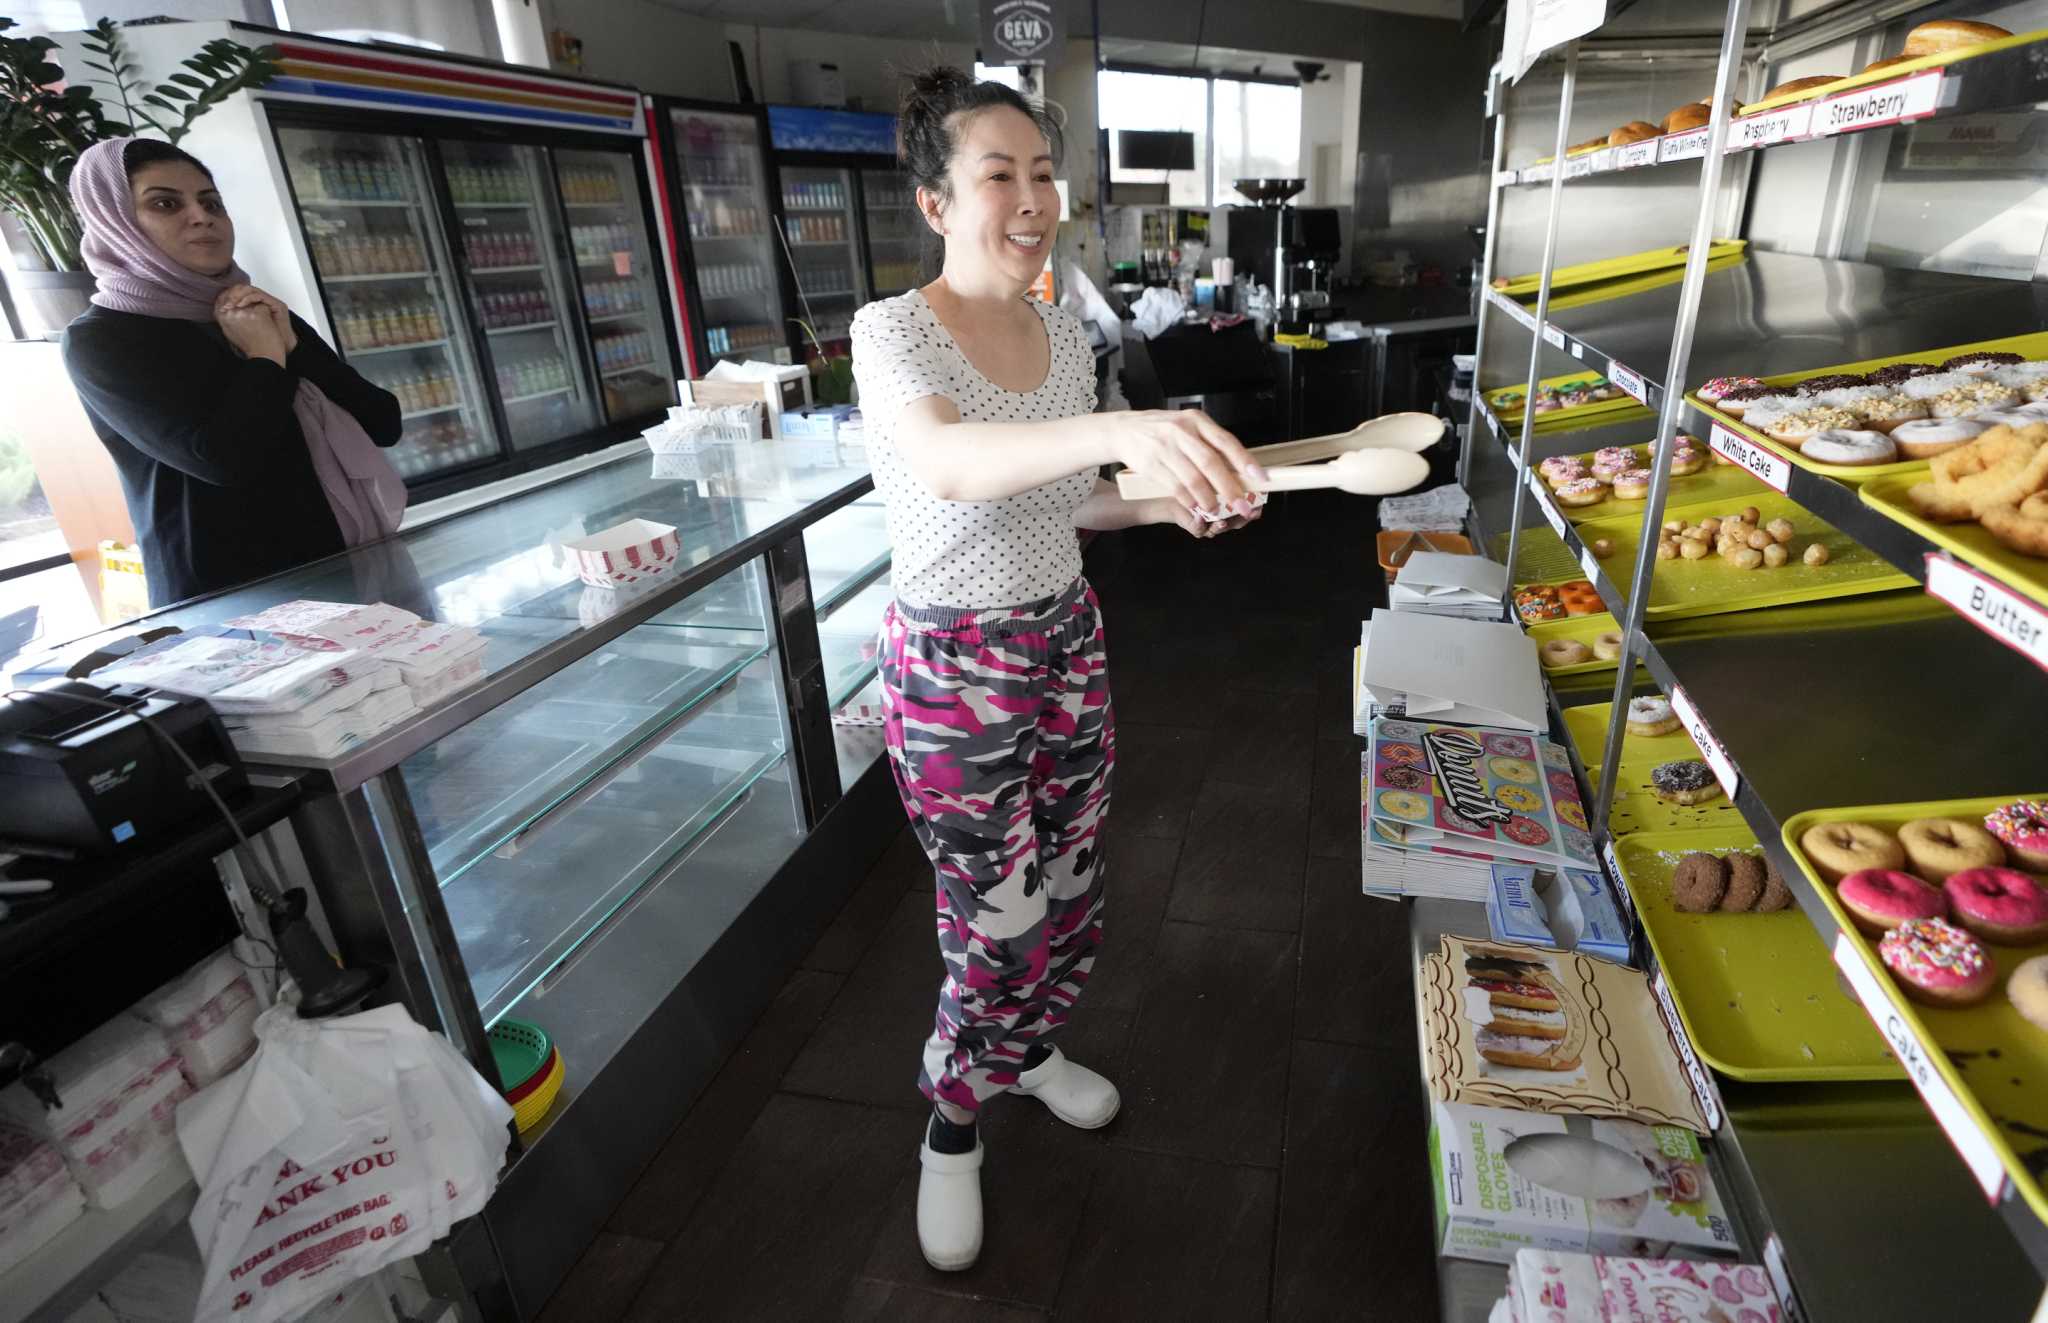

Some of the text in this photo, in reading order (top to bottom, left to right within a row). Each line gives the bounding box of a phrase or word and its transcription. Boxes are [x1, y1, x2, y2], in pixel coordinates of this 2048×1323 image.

[1004, 20, 1042, 40] GEVA
[1743, 117, 1789, 141] Raspberry
[1829, 90, 1908, 125] Strawberry
[1615, 369, 1638, 395] Chocolate
[1722, 434, 1772, 478] White Cake
[1970, 584, 2042, 647] Butter
[1693, 723, 1712, 758] Cake
[1420, 732, 1513, 828] Donuts
[1608, 854, 1628, 903] Powder
[1660, 986, 1713, 1118] Blueberry Cake
[1888, 1013, 1928, 1086] Cake
[1470, 1120, 1494, 1210] DISPOSABLE
[1656, 1127, 1678, 1157] ONE
[1673, 1128, 1695, 1160] SIZE
[253, 1175, 330, 1229] ANK
[331, 1150, 396, 1186] YOU
[1491, 1152, 1512, 1212] GLOVES
[230, 1245, 275, 1282] PLEASE
[278, 1218, 332, 1250] RECYCLE
[334, 1203, 362, 1225] THIS
